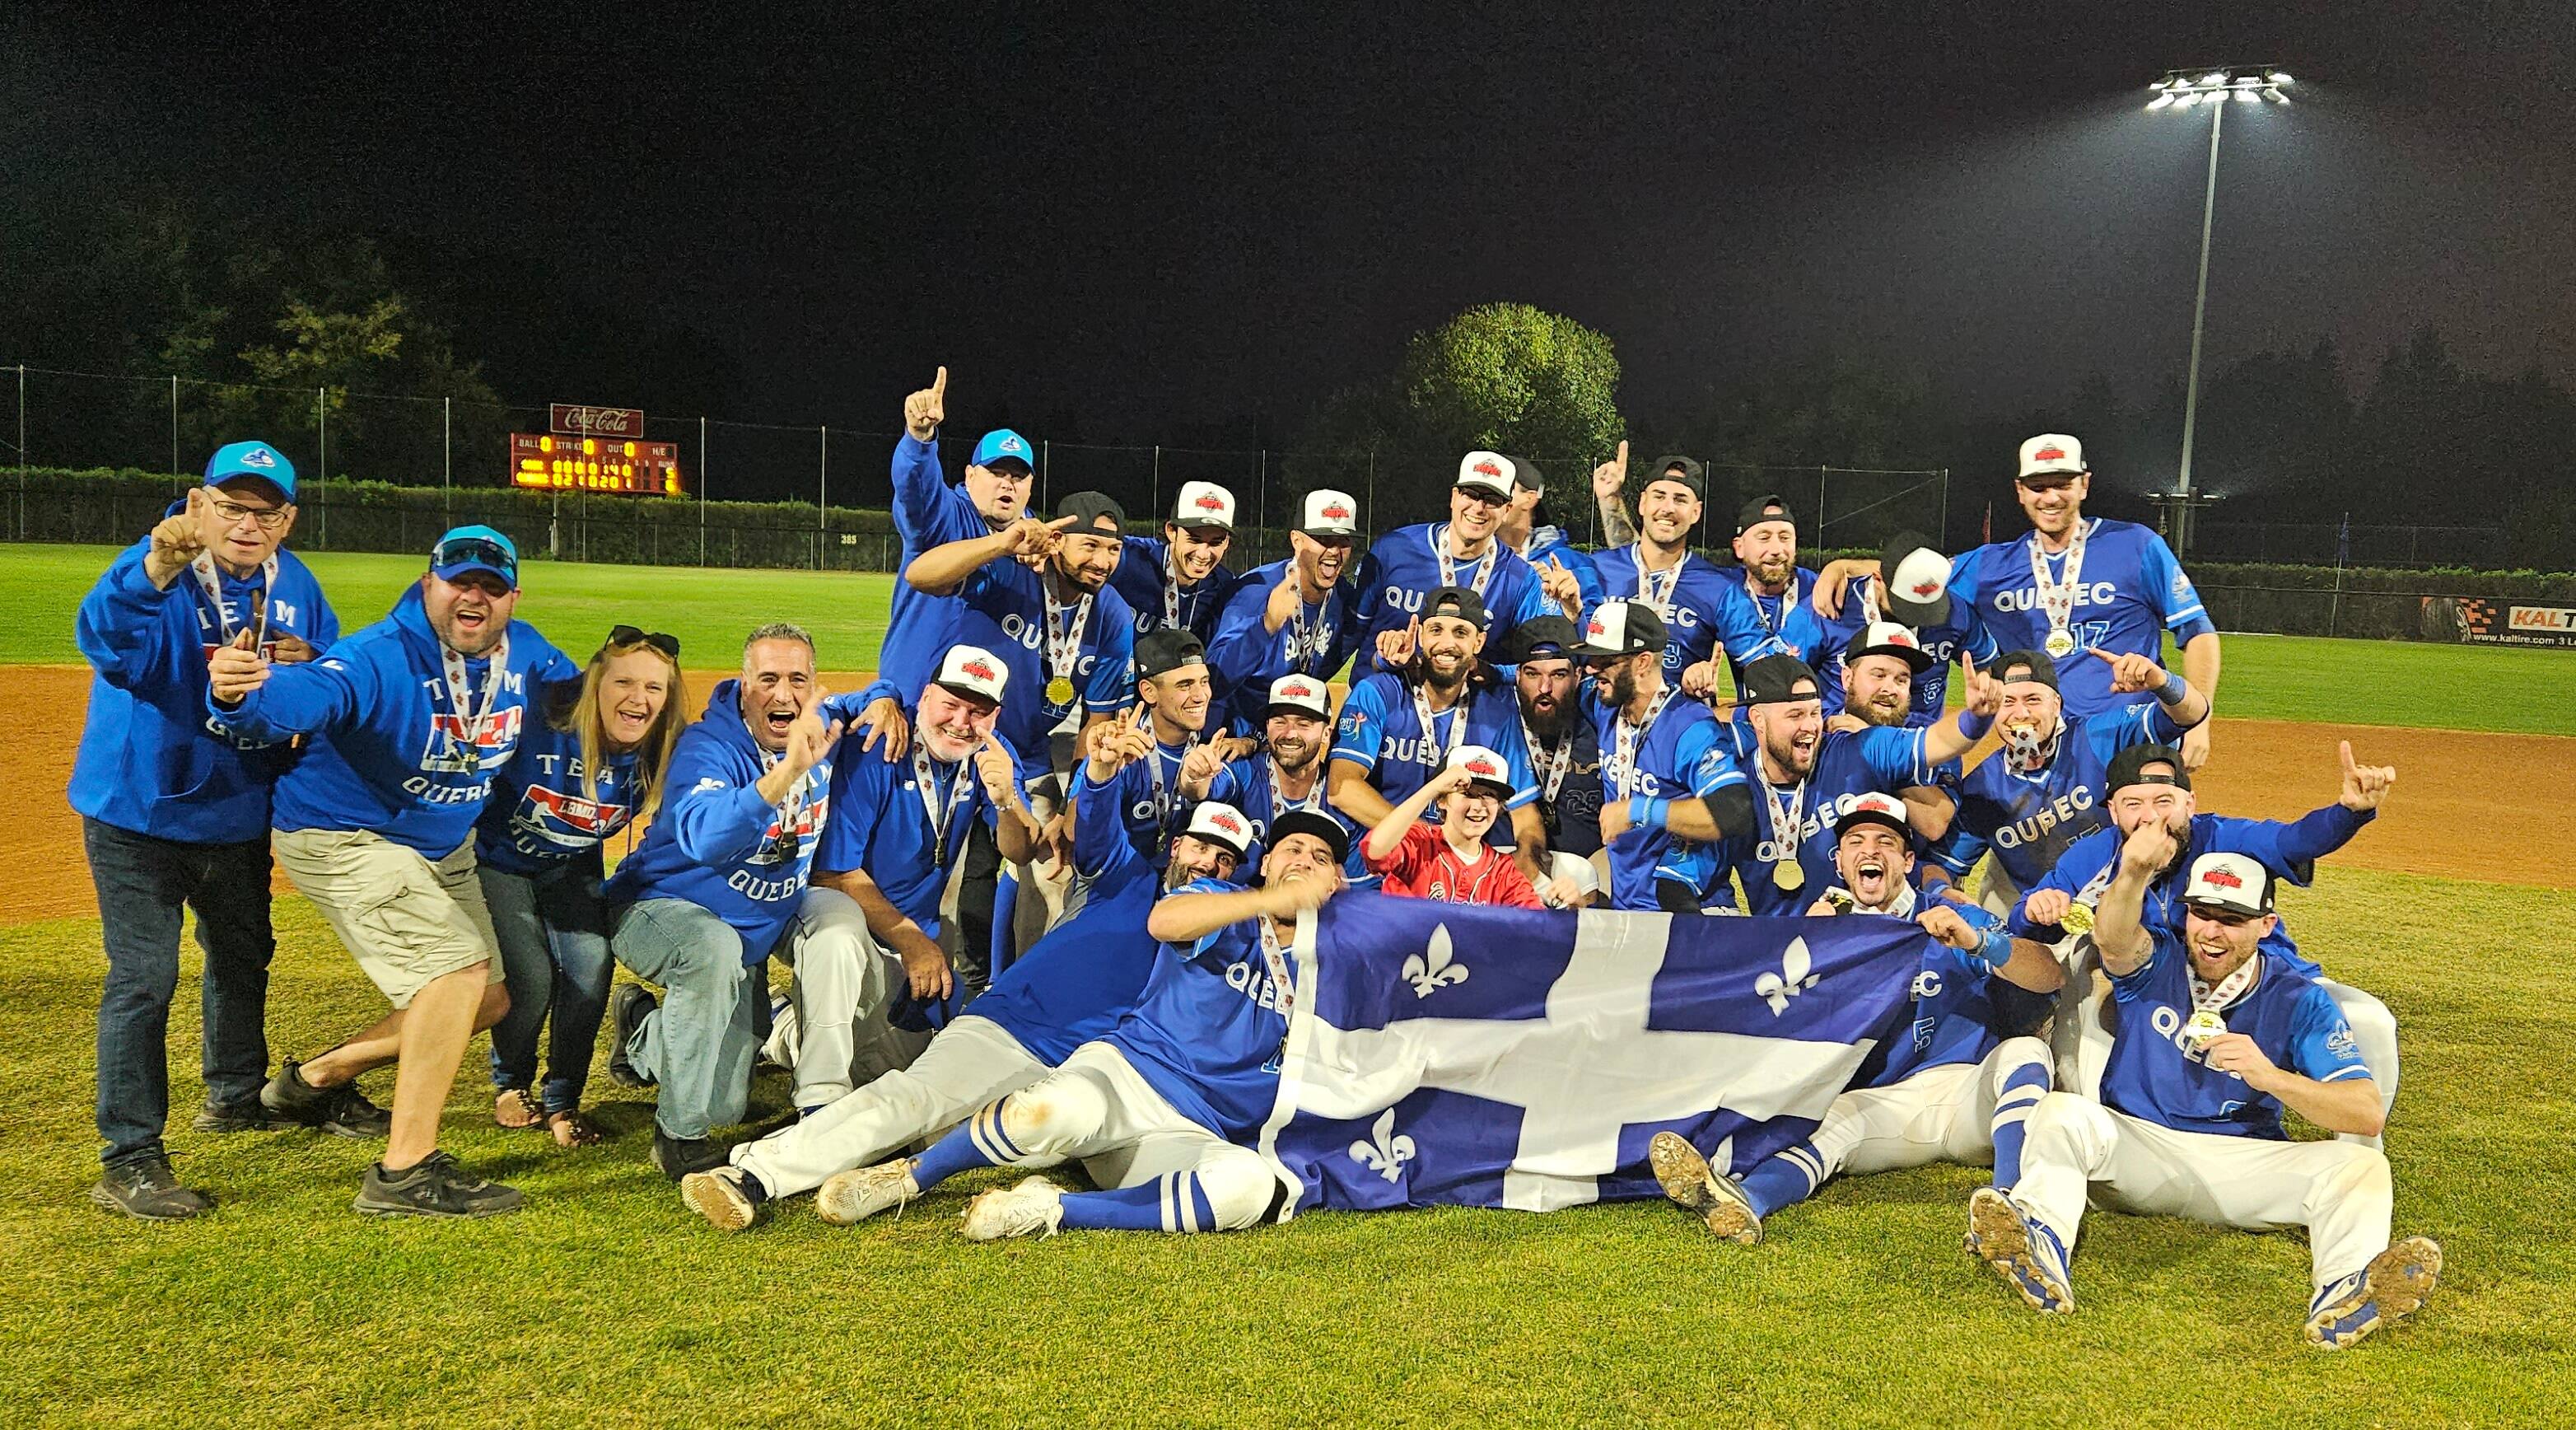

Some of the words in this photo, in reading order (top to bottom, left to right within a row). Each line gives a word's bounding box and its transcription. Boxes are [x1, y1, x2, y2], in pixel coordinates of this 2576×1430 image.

[520, 439, 538, 448] BALL
[608, 445, 623, 453] OUT
[1994, 582, 2116, 612] QUEC
[2070, 620, 2110, 656] 17
[2473, 633, 2555, 646] www.kaltire.com
[2558, 637, 2565, 645] 3
[728, 862, 813, 902] QUEBE
